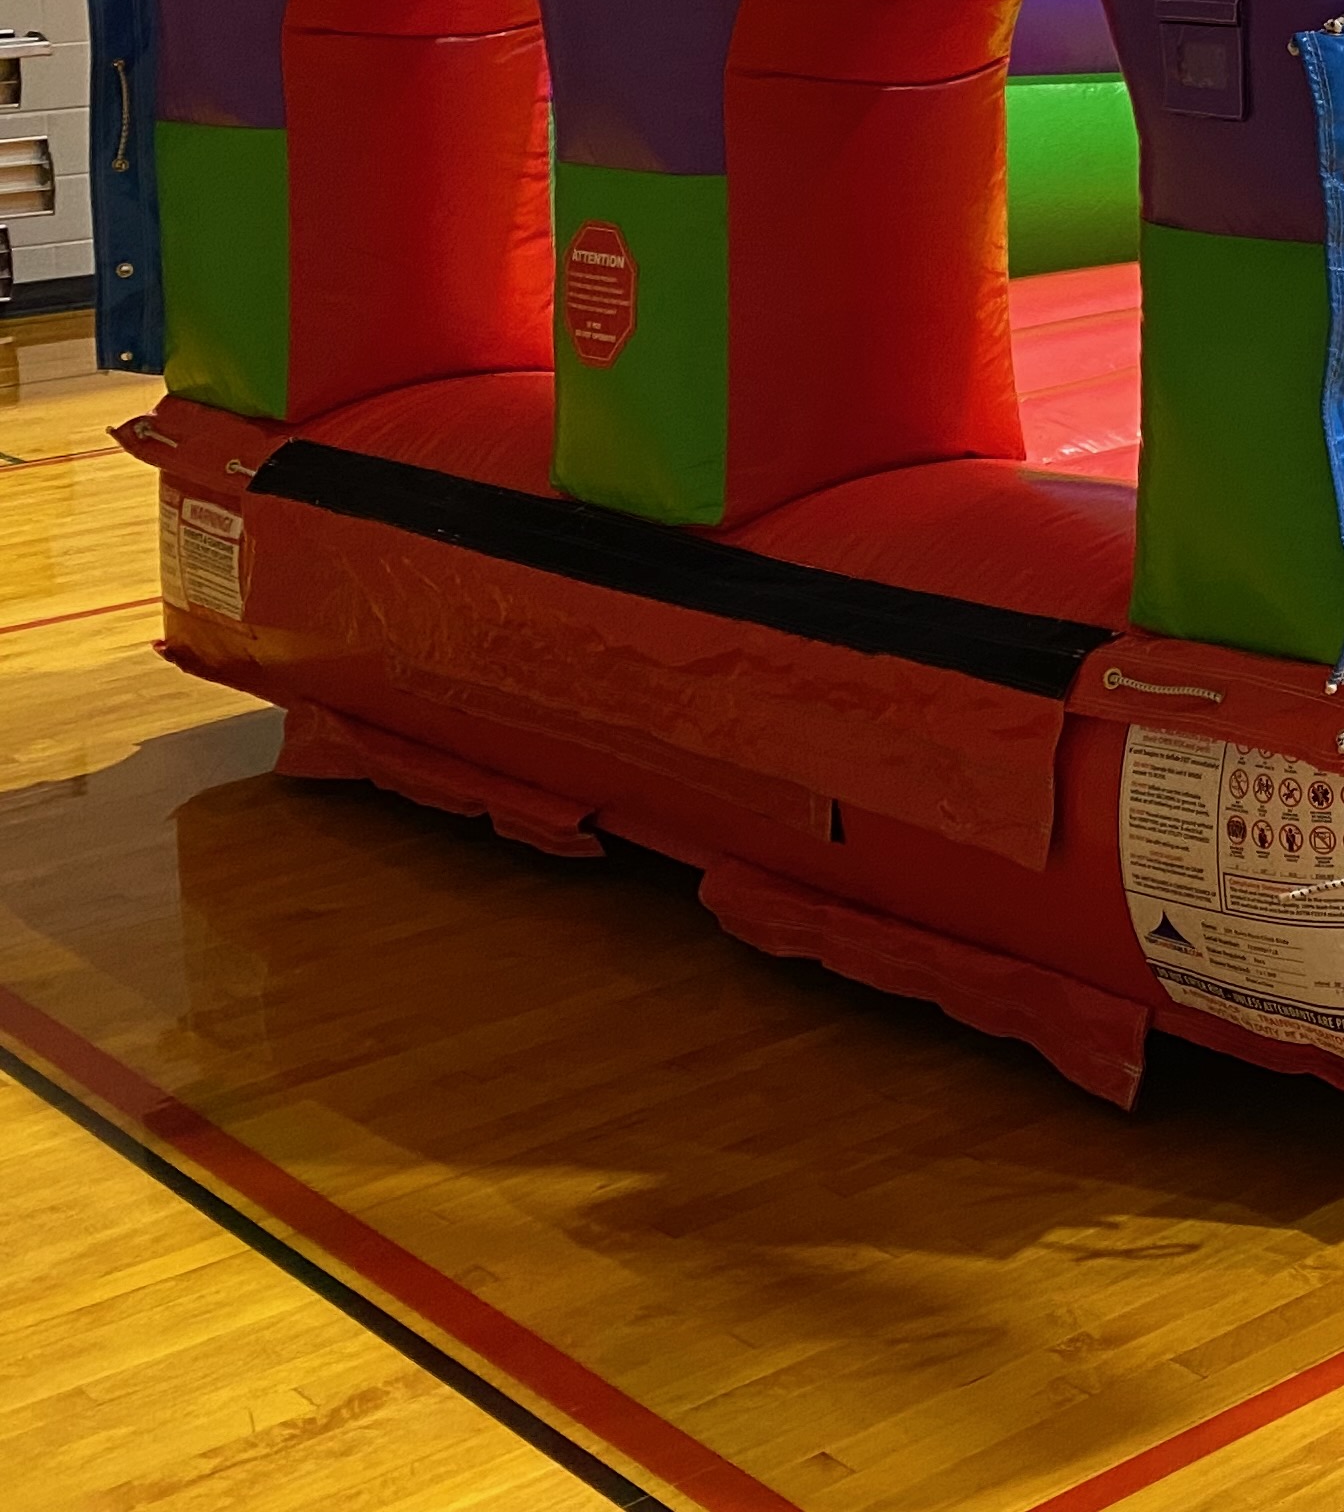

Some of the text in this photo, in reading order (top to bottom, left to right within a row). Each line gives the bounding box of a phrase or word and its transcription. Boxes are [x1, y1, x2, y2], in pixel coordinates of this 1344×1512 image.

[572, 248, 625, 269] ATTENTION
[1232, 992, 1263, 1009] UNLESS
[1263, 1001, 1317, 1023] ATTENDANTS
[1317, 1014, 1335, 1028] ARE
